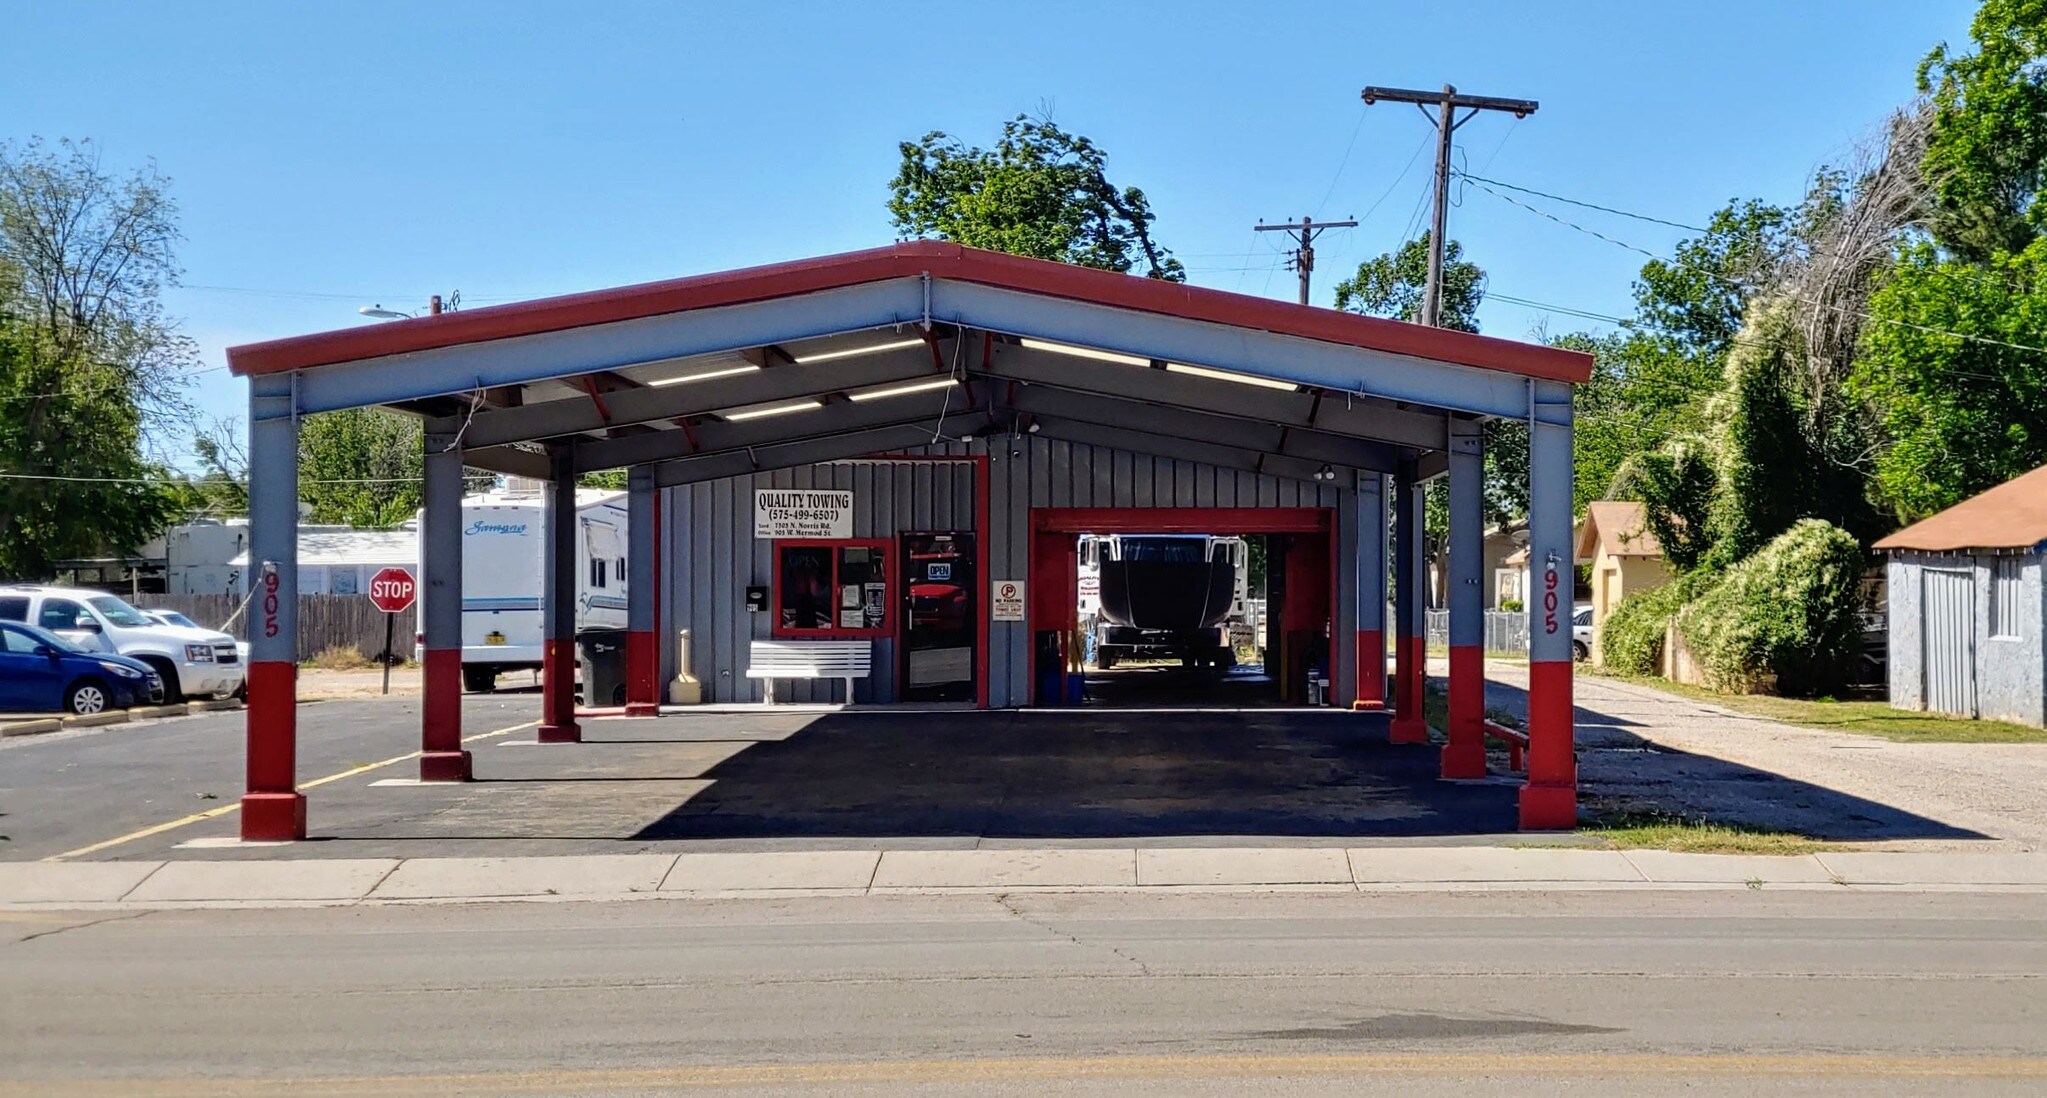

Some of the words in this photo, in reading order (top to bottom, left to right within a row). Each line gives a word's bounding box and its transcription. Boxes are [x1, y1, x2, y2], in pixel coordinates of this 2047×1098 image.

[759, 493, 805, 511] QUALITY
[806, 494, 849, 509] TOWING
[768, 509, 839, 522] (575-499-6507)
[788, 555, 820, 569] OPEN
[930, 565, 949, 575] OPEN
[372, 581, 413, 599] STOP
[264, 572, 279, 638] 905
[1544, 569, 1558, 635] 905
